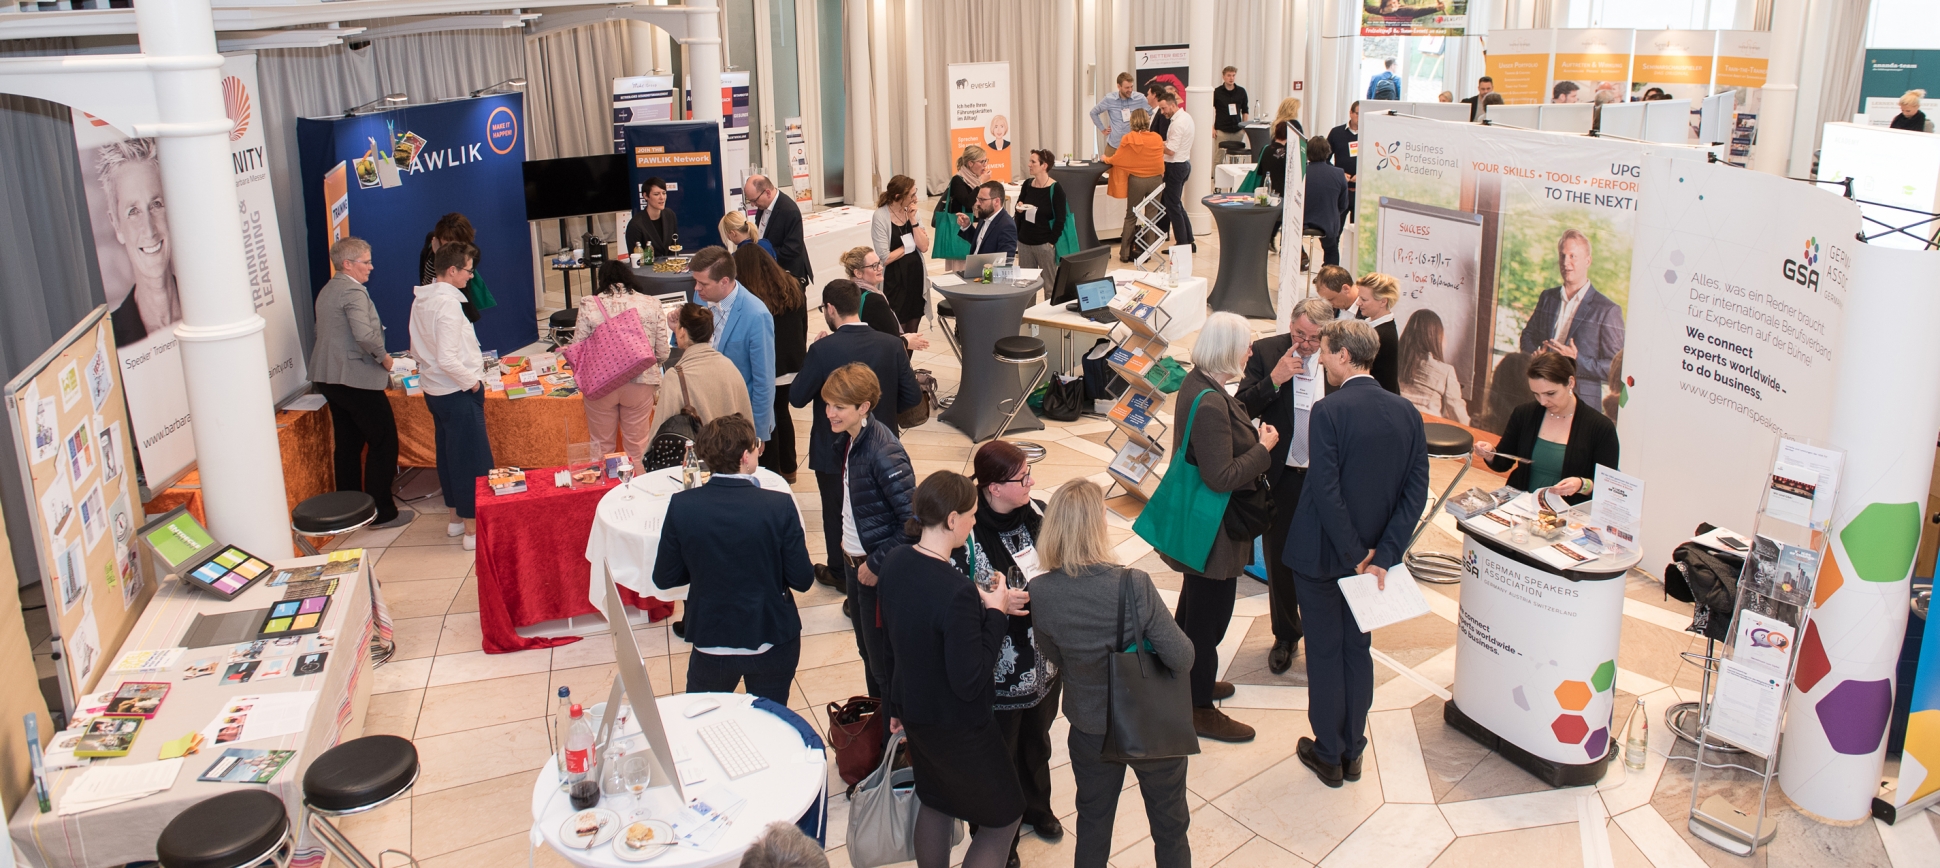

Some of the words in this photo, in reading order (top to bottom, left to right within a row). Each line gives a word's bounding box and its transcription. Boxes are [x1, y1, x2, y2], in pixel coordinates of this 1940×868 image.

[970, 81, 996, 90] everskill
[492, 122, 505, 130] MAKE
[492, 130, 512, 138] HAPPEN!
[409, 142, 482, 176] AWLIK
[638, 156, 671, 164] PAWLIK
[674, 155, 710, 163] Network
[1404, 153, 1459, 169] Professional
[1405, 142, 1444, 155] Business
[1404, 164, 1444, 180] Academy
[1472, 161, 1500, 174] YOUR
[1503, 166, 1536, 180] SKILLS
[1546, 171, 1581, 186] TOOLS
[1590, 177, 1639, 192] PERFOR
[1610, 162, 1640, 178] UPG
[1544, 186, 1562, 200] TO
[1565, 189, 1591, 205] THE
[1594, 194, 1632, 210] NEXT
[1400, 222, 1431, 236] SUCCESS
[242, 220, 264, 313] TRAINING
[250, 210, 275, 307] LEARNING
[1782, 258, 1820, 293] GSA
[1690, 272, 1722, 292] Alles,
[1724, 282, 1746, 298] was
[1748, 289, 1764, 304] ein
[1765, 294, 1797, 318] Redner
[1688, 304, 1704, 319] für
[1706, 309, 1754, 336] Experten
[1755, 328, 1772, 343] auf
[1772, 335, 1786, 352] der
[1787, 340, 1813, 368] Bühne!
[1690, 288, 1710, 302] Der
[1712, 294, 1780, 329] internationale
[1781, 319, 1832, 362] Berufsverband
[1686, 324, 1706, 341] We
[1707, 332, 1754, 359] connect
[1682, 359, 1694, 372] to
[1696, 364, 1712, 378] do
[1714, 369, 1763, 401] business.
[1683, 344, 1728, 367] experts
[1729, 359, 1781, 393] worldwide
[142, 413, 192, 449] www.barbara
[1484, 568, 1543, 598] ASSOCIATION
[1485, 558, 1521, 580] GERMAN
[1524, 576, 1580, 598] SPEAKERS
[1484, 579, 1508, 594] GERMANY
[1508, 591, 1532, 604] AUSTRIA
[1532, 600, 1578, 618] SWITZERLAND
[1464, 610, 1490, 633] connect
[1468, 632, 1500, 656] business.
[1475, 628, 1516, 655] worldwide
